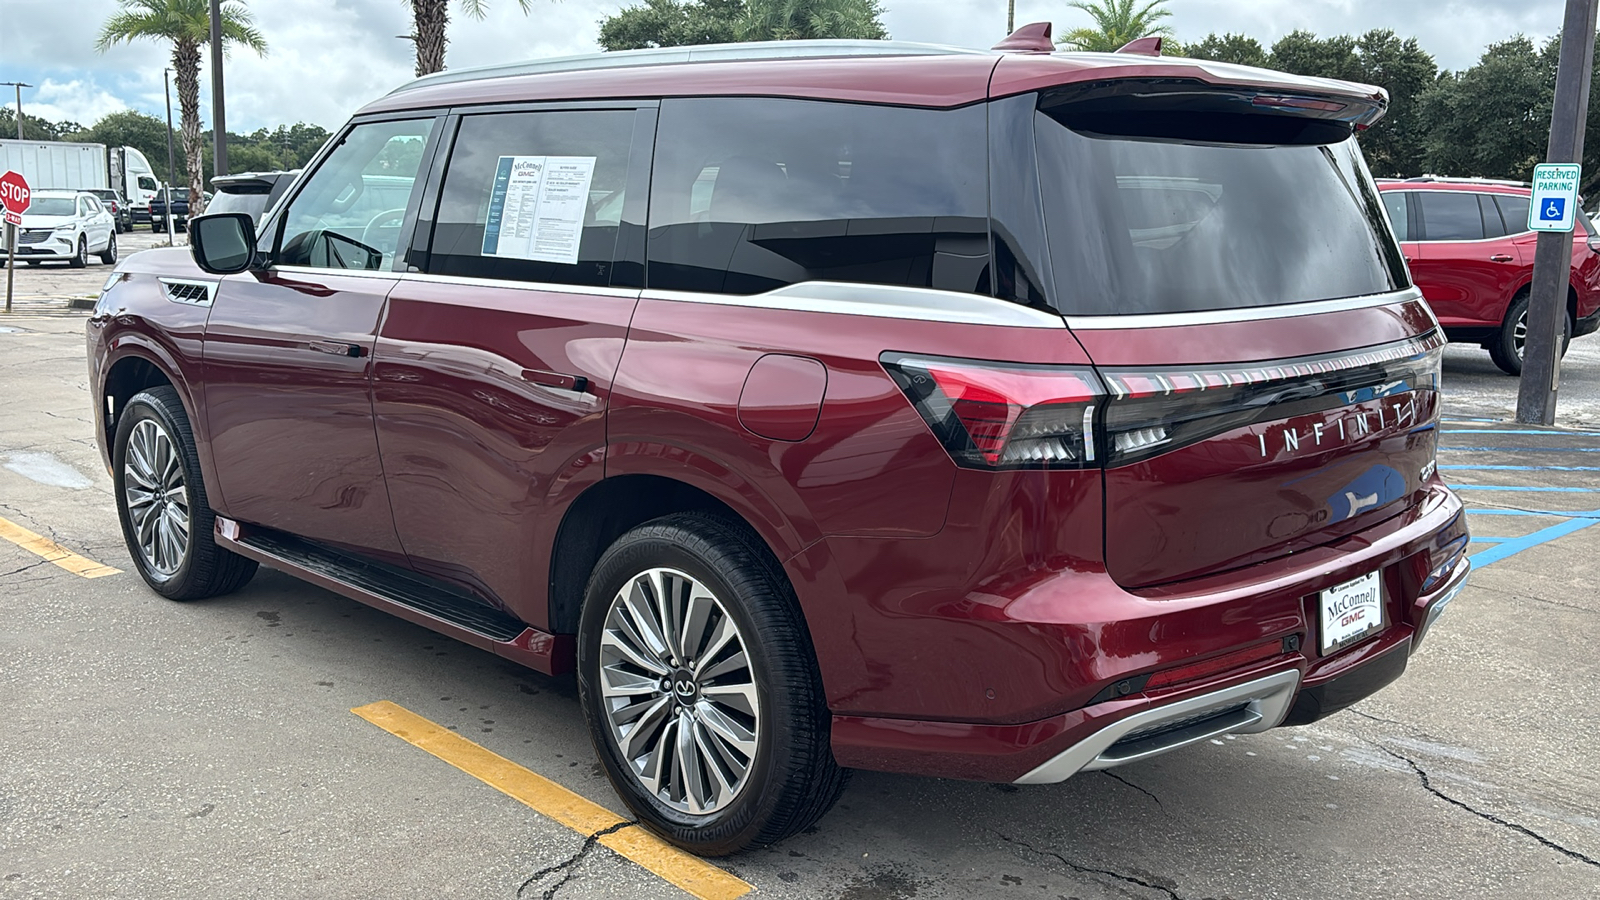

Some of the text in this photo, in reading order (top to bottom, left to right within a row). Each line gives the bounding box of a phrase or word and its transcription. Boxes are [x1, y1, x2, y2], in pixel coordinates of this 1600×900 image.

[514, 161, 542, 172] McConnell
[1537, 171, 1576, 180] RESERVED
[1, 181, 29, 204] STOP
[1538, 182, 1572, 191] PARKING
[1258, 399, 1416, 457] INFINITI
[1328, 587, 1376, 622] McConnell
[1342, 609, 1365, 627] GMC
